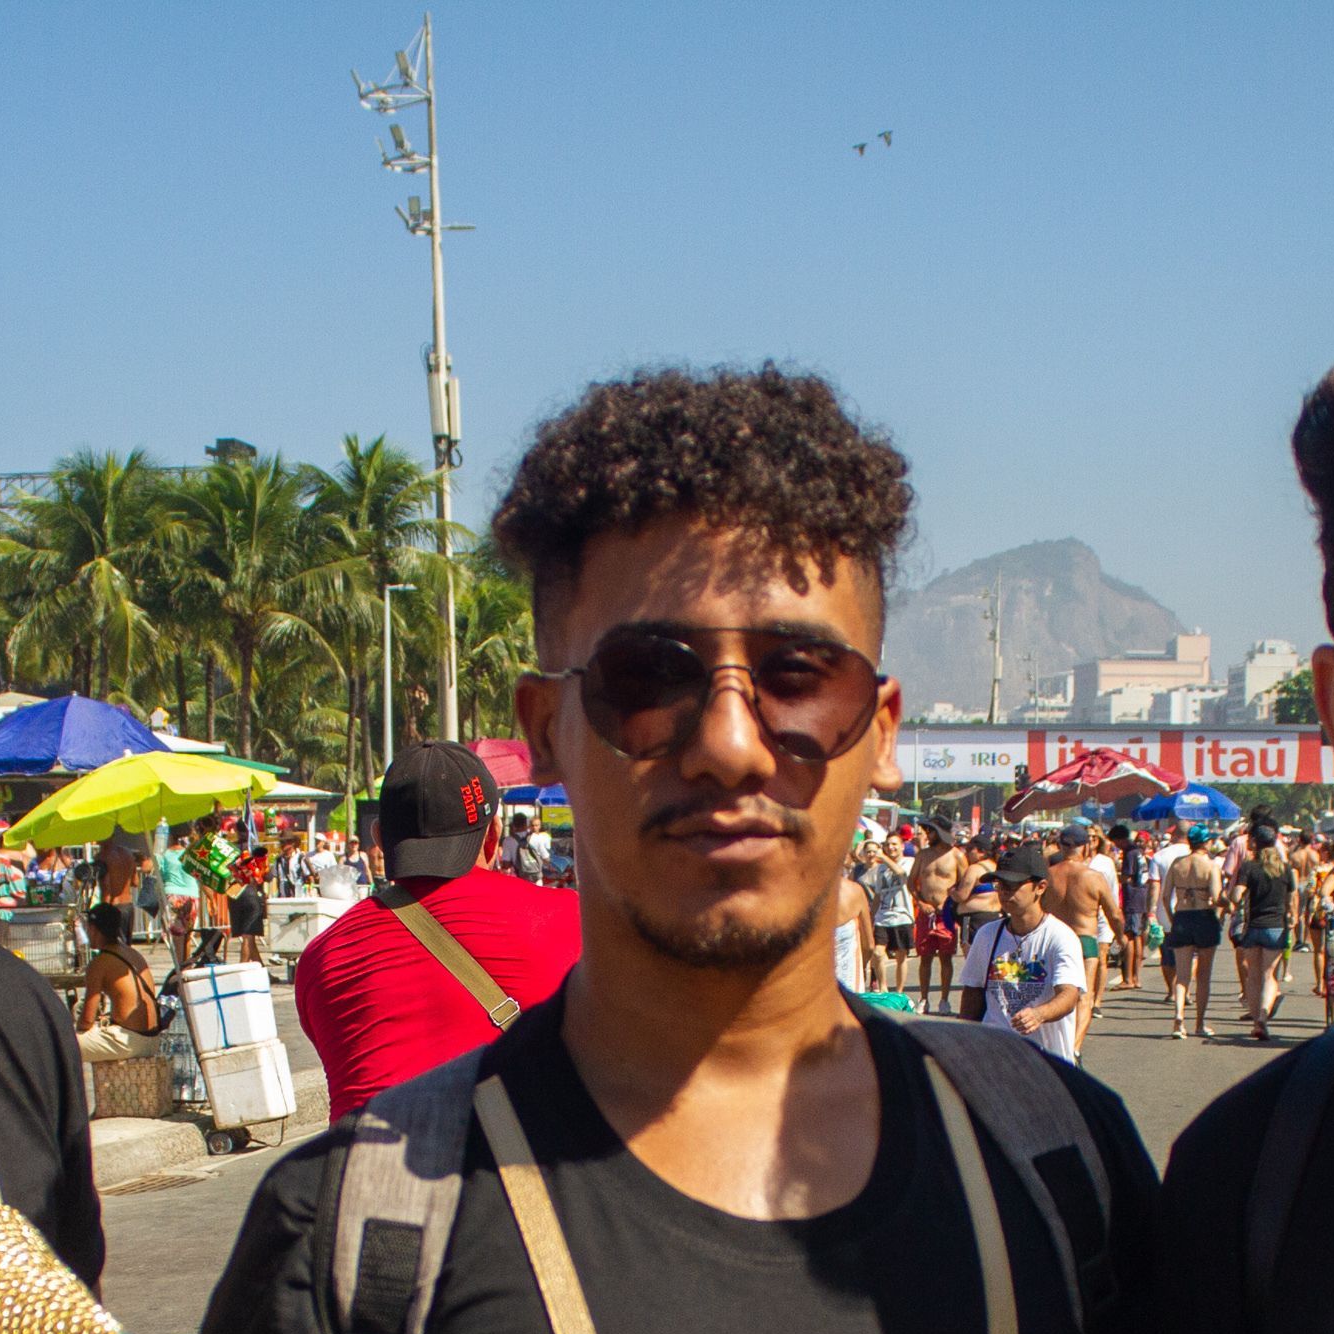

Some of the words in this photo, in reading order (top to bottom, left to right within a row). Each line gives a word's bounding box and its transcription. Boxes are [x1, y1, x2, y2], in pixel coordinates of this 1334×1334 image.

[923, 758, 947, 769] G20
[978, 752, 1011, 766] RIO
[1195, 735, 1285, 777] itaú
[471, 776, 484, 804] LEO
[460, 785, 478, 824] PARD
